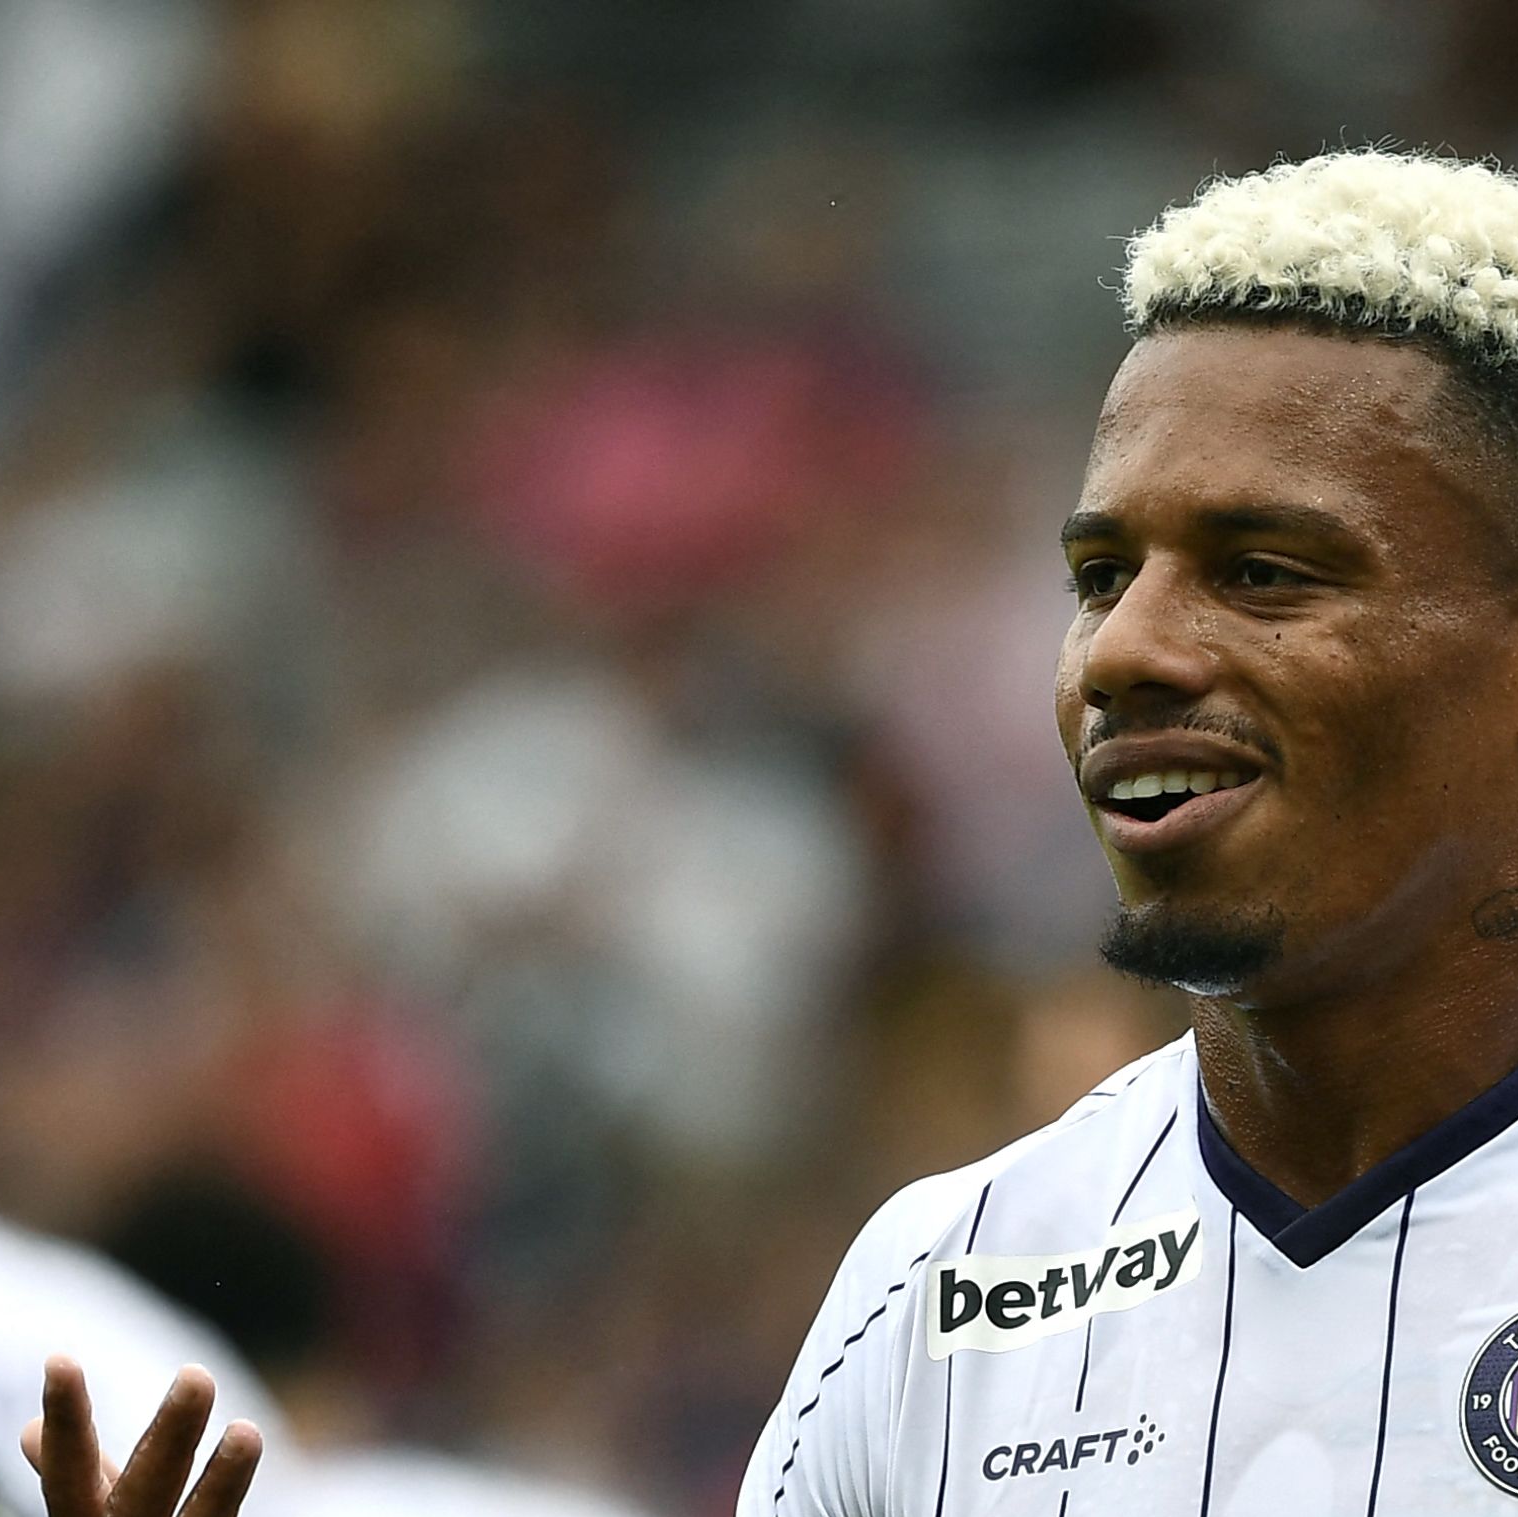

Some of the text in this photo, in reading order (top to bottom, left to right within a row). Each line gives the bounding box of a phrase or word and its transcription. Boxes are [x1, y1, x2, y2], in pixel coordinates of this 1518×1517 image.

[939, 1216, 1201, 1333] betway
[1472, 1394, 1492, 1410] 19
[982, 1428, 1129, 1481] CRAFT
